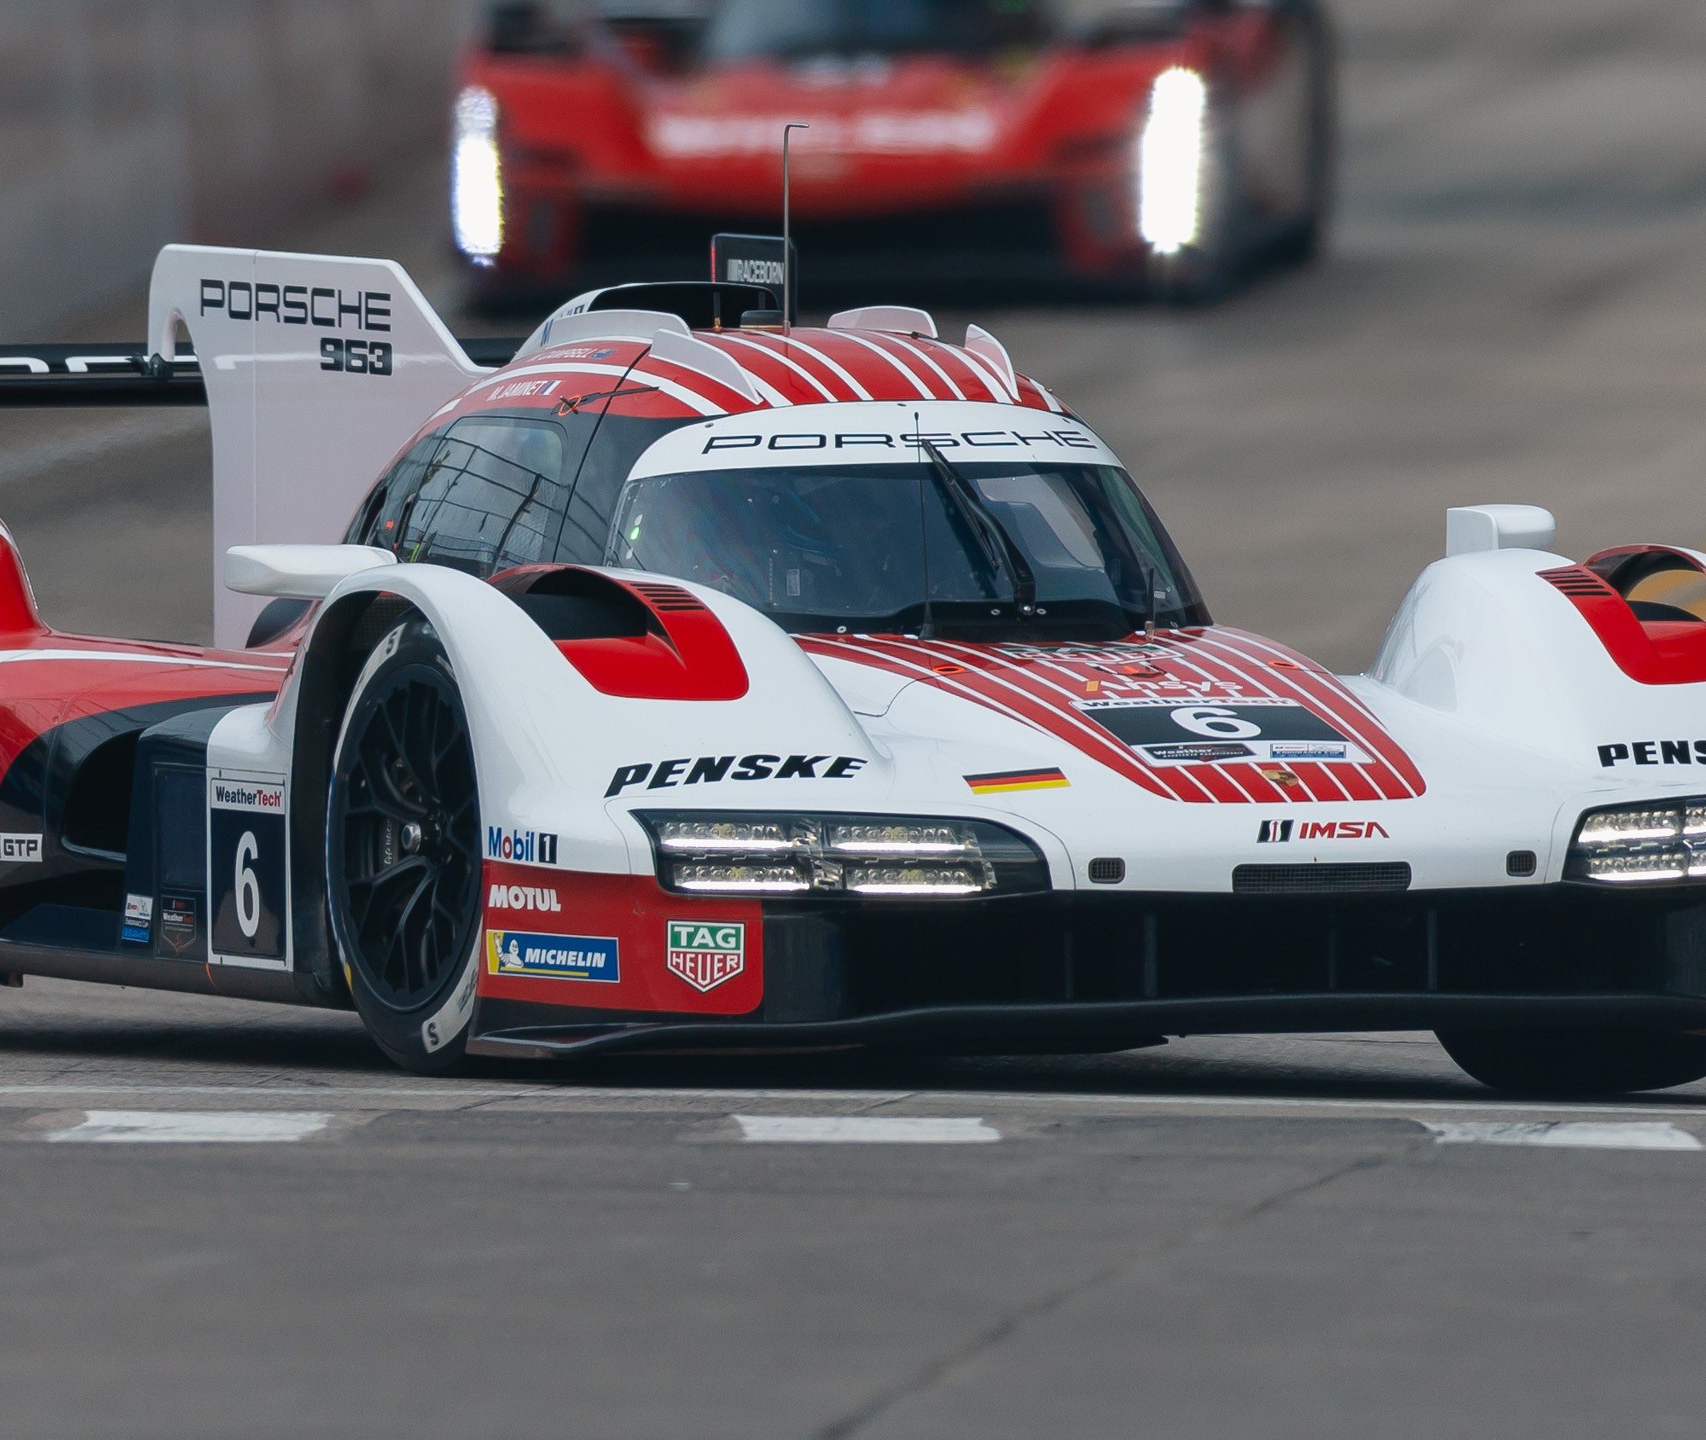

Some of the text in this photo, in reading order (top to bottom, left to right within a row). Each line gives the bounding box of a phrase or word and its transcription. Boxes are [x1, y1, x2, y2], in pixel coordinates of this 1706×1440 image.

[737, 259, 784, 284] RACEBORN
[200, 278, 391, 332] PORSCHE
[319, 337, 393, 376] 963
[701, 431, 1099, 455] PORSCHE
[1084, 680, 1243, 693] Ansys
[1170, 706, 1262, 738] 6
[603, 754, 869, 799] PENSKE
[216, 786, 281, 807] WeatherTech
[1298, 821, 1391, 839] IMSA
[3, 838, 38, 857] GTP
[488, 825, 535, 862] Mobil
[235, 831, 260, 938] 6
[488, 884, 562, 912] MOTUL
[673, 926, 737, 949] TAG
[525, 947, 606, 968] MICHELIN
[672, 952, 739, 986] HEUER
[427, 1022, 440, 1046] S
